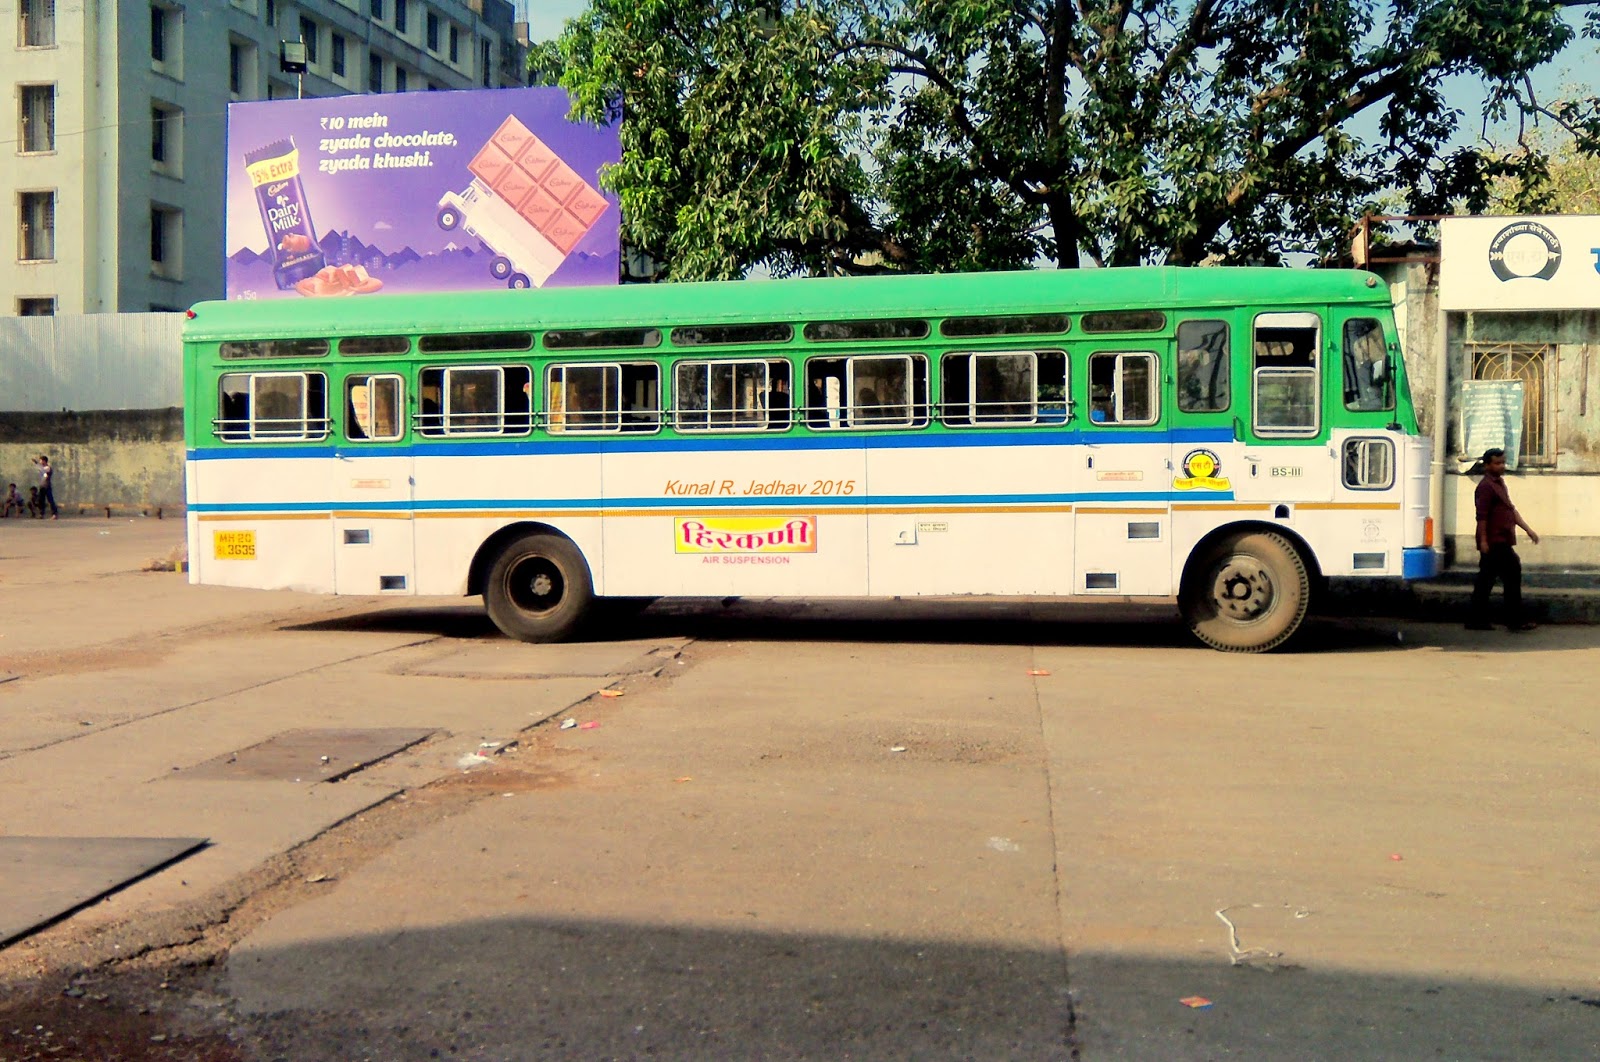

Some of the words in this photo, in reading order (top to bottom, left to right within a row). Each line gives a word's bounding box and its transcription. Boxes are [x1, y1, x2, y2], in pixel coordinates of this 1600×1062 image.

[348, 112, 388, 129] mein
[319, 134, 370, 154] zyada
[373, 130, 458, 148] chocolate,
[319, 154, 369, 174] zyada
[373, 151, 433, 169] khushi.
[268, 202, 299, 221] Dairy
[1271, 467, 1301, 476] BS-III
[219, 533, 235, 543] MH
[681, 520, 808, 550] हिरकणी
[702, 556, 720, 565] AIR
[723, 556, 790, 565] SUSPENSION
